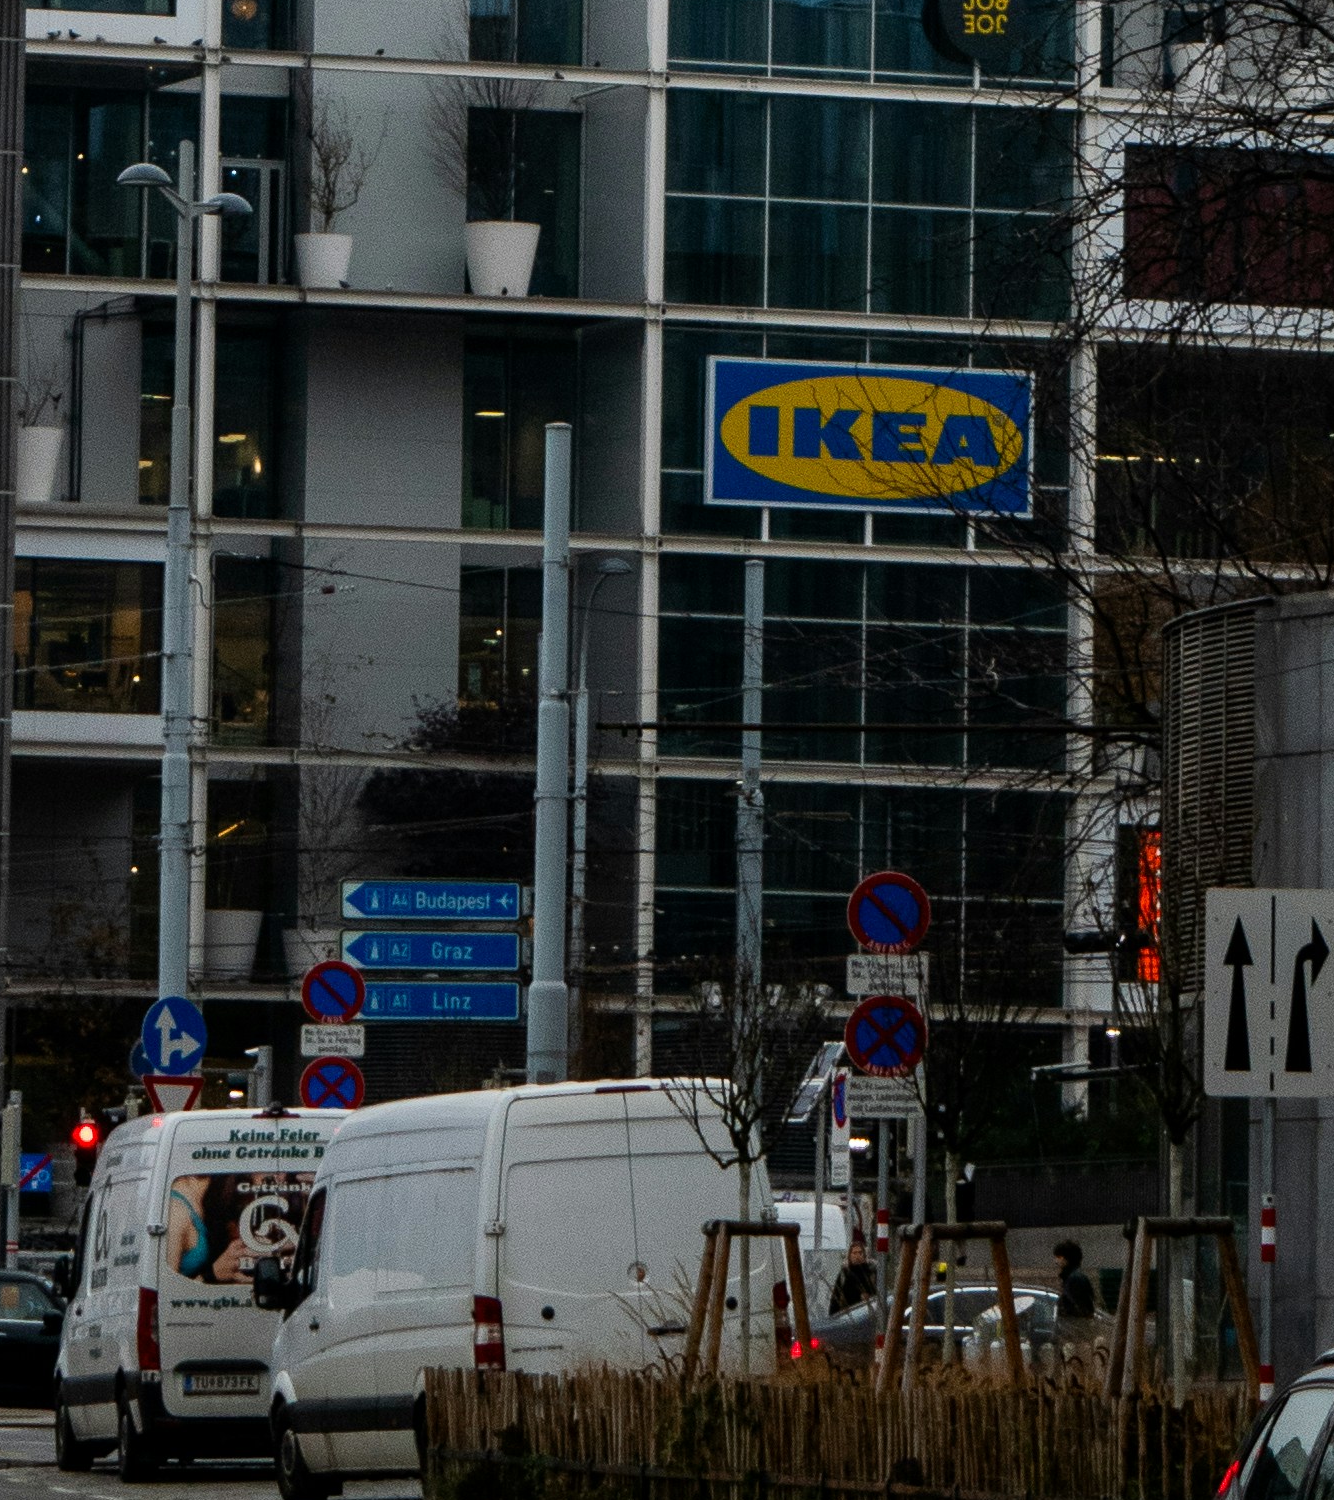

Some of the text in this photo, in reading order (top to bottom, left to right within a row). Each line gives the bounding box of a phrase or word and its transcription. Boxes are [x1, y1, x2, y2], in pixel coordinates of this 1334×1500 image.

[747, 404, 998, 468] IKEA
[392, 890, 490, 912] A4 Budapest
[392, 941, 473, 961] A2 Graz
[392, 991, 472, 1011] A1 Linz
[228, 1128, 320, 1143] Keine Feier
[192, 1146, 231, 1160] ohne
[236, 1181, 313, 1193] Getränk
[170, 1296, 253, 1311] www.gbk.a
